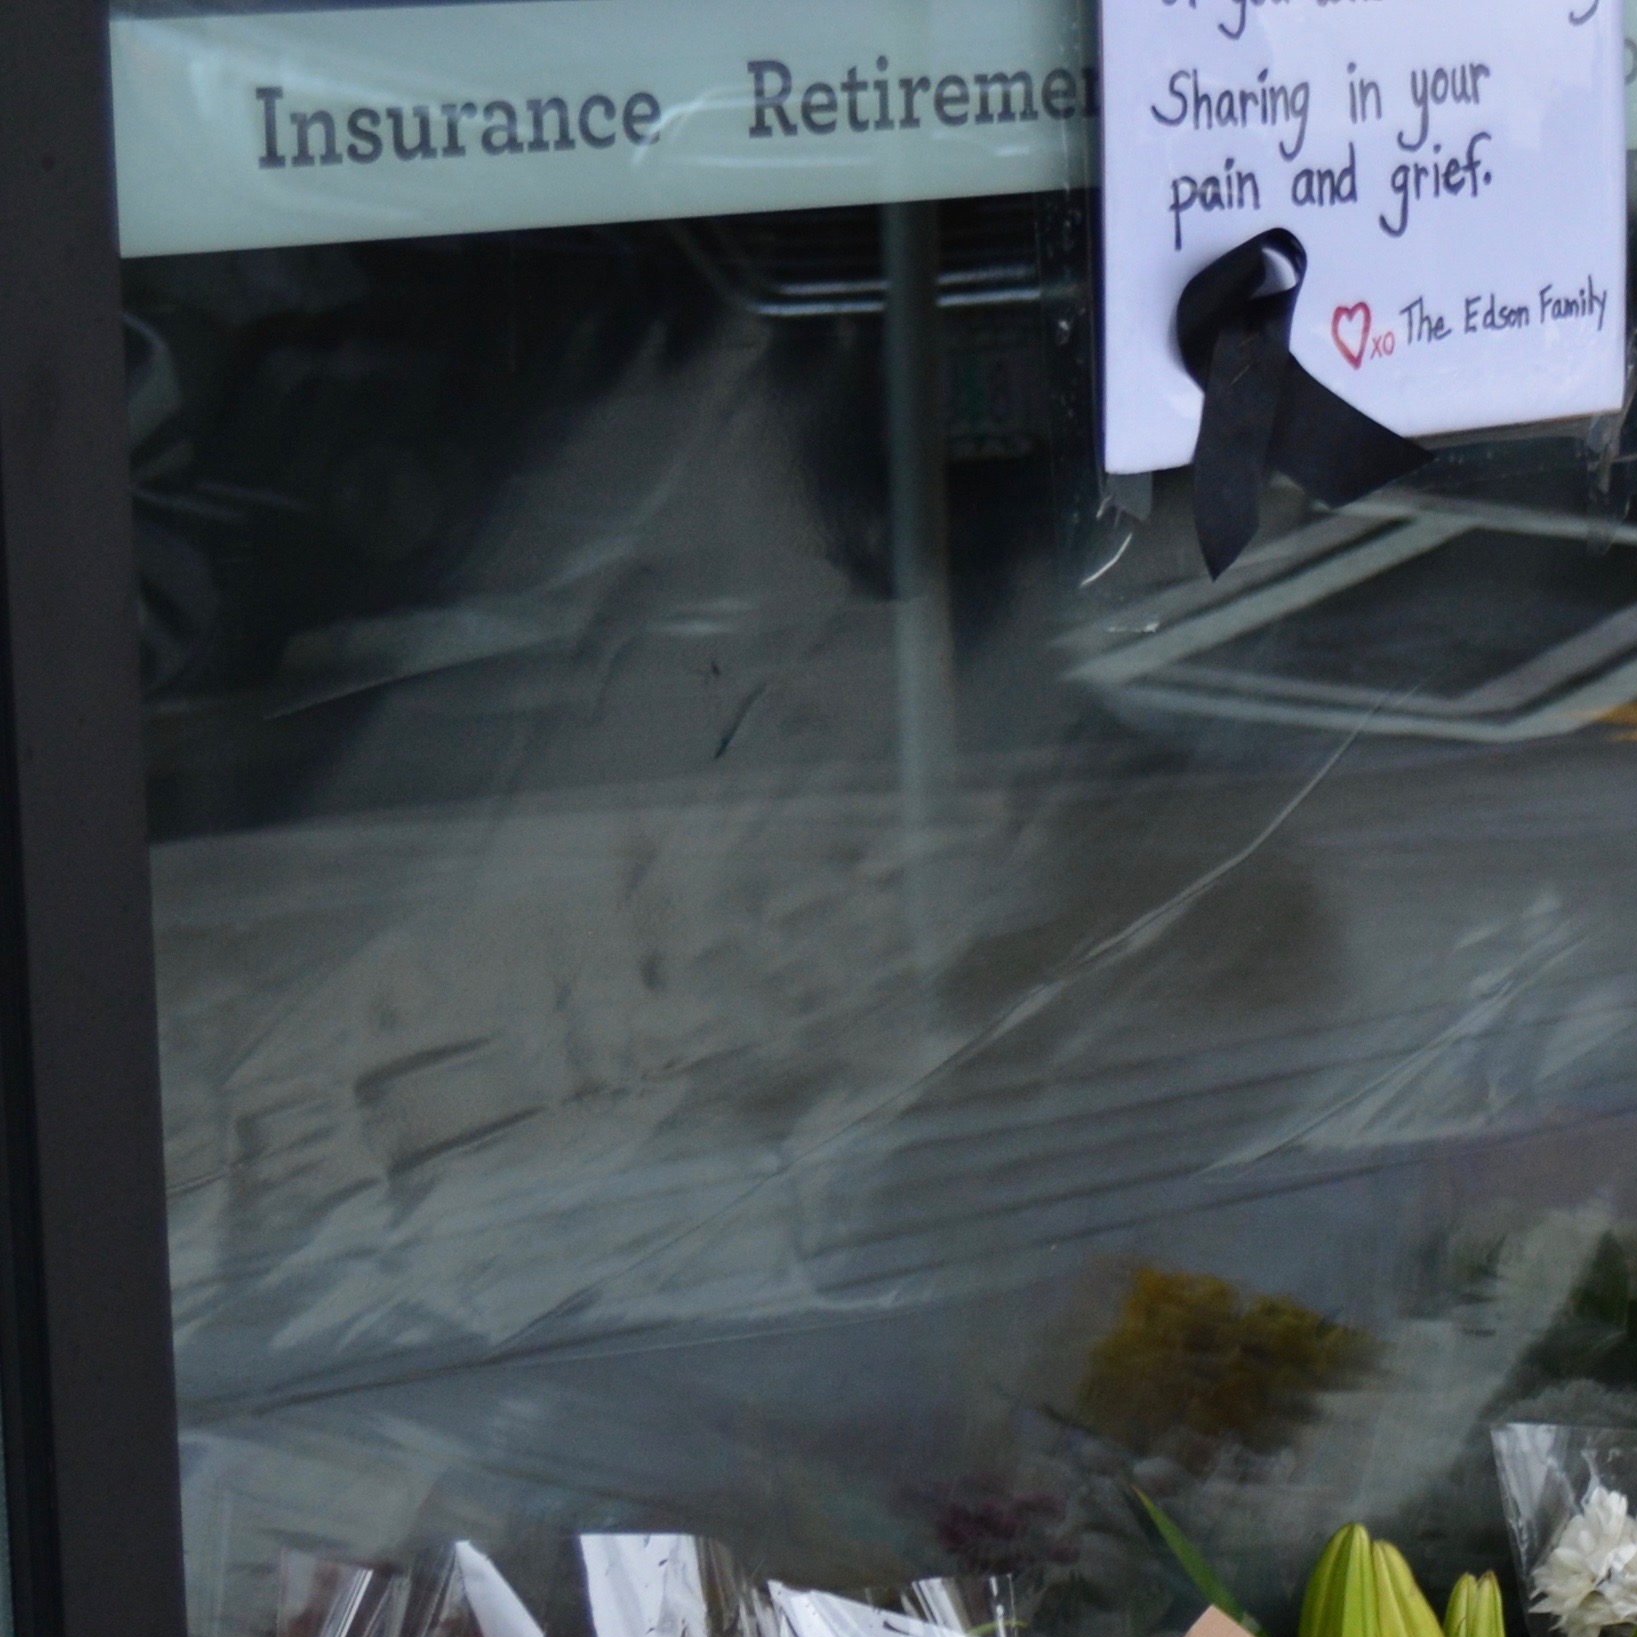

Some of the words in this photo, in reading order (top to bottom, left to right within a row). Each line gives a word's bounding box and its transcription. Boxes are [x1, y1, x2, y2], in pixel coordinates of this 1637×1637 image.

[255, 85, 661, 170] Insurance
[746, 55, 1101, 138] Retireme
[1151, 68, 1310, 161] Sharing
[1348, 62, 1382, 125] in
[1397, 61, 1491, 152] your
[1169, 158, 1261, 250] pain
[1291, 142, 1358, 207] and
[1379, 131, 1493, 238] grief.
[1399, 296, 1452, 345] The
[1464, 293, 1530, 334] Edson
[1539, 274, 1608, 331] Family
